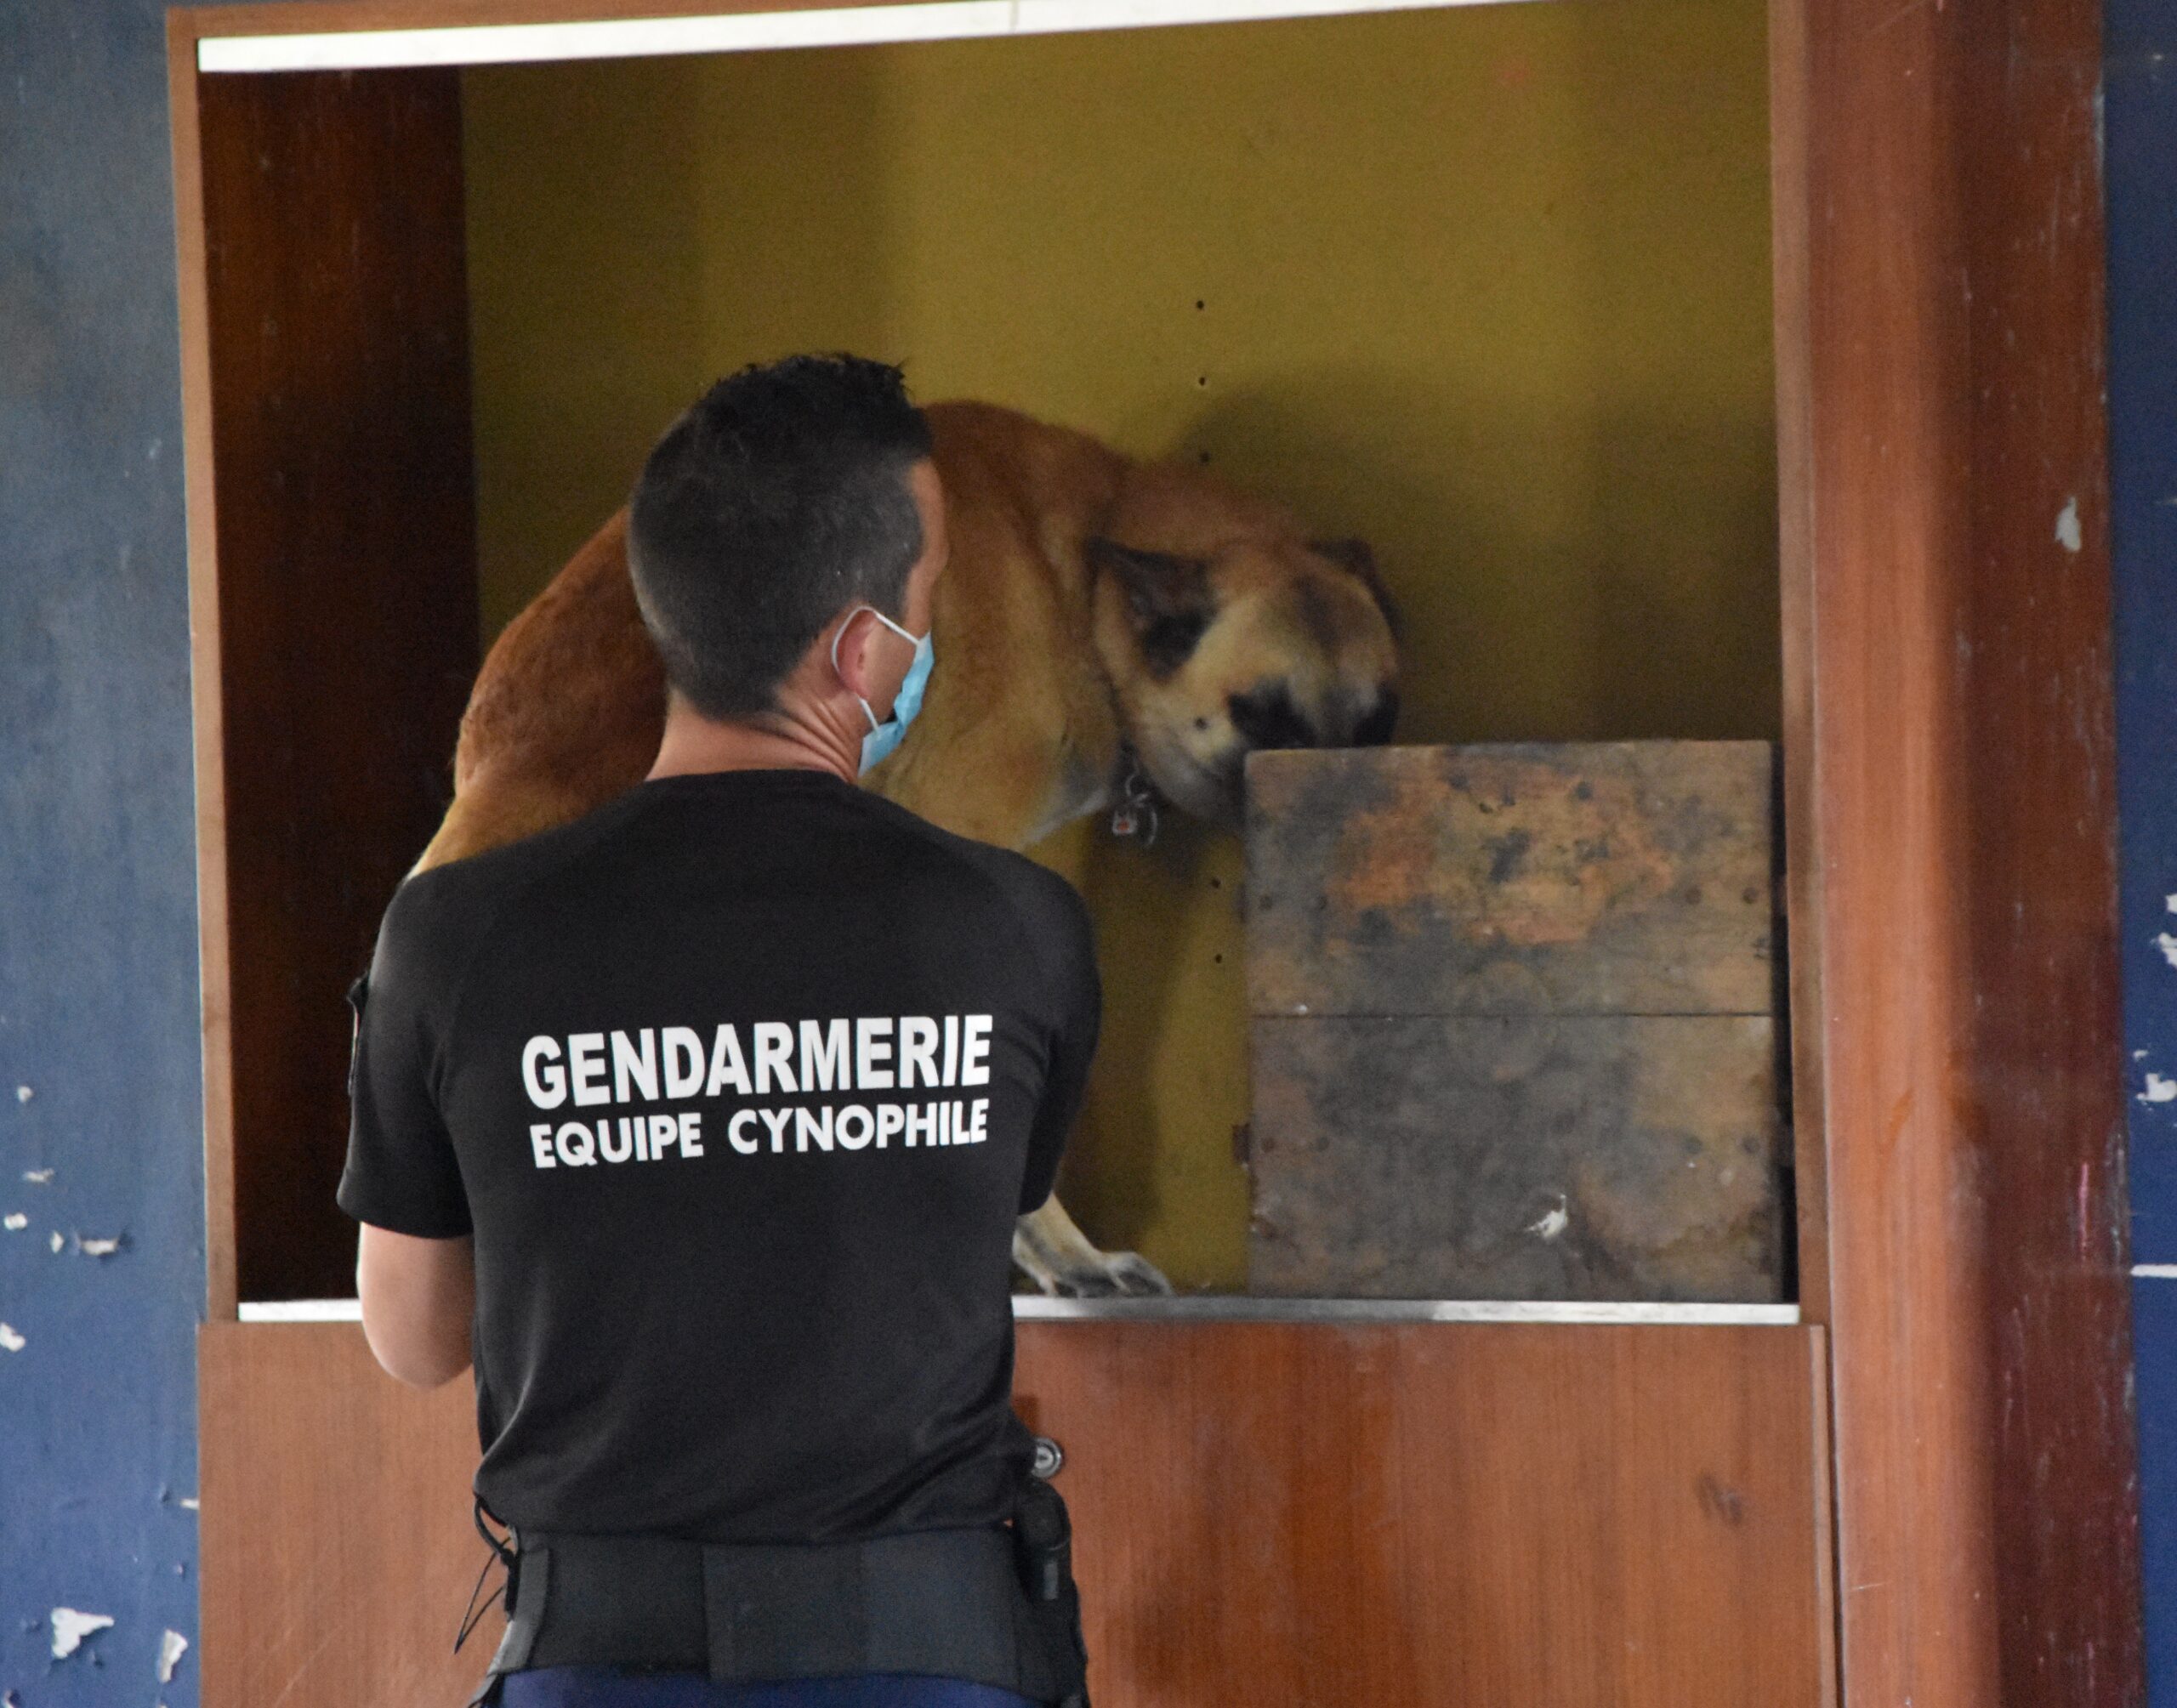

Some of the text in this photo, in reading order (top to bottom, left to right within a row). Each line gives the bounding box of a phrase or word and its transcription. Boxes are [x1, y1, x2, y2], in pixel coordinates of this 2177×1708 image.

[521, 1014, 993, 1109] GENDARMERIE
[529, 1098, 990, 1168] EQUIPE CYNOPHILE
